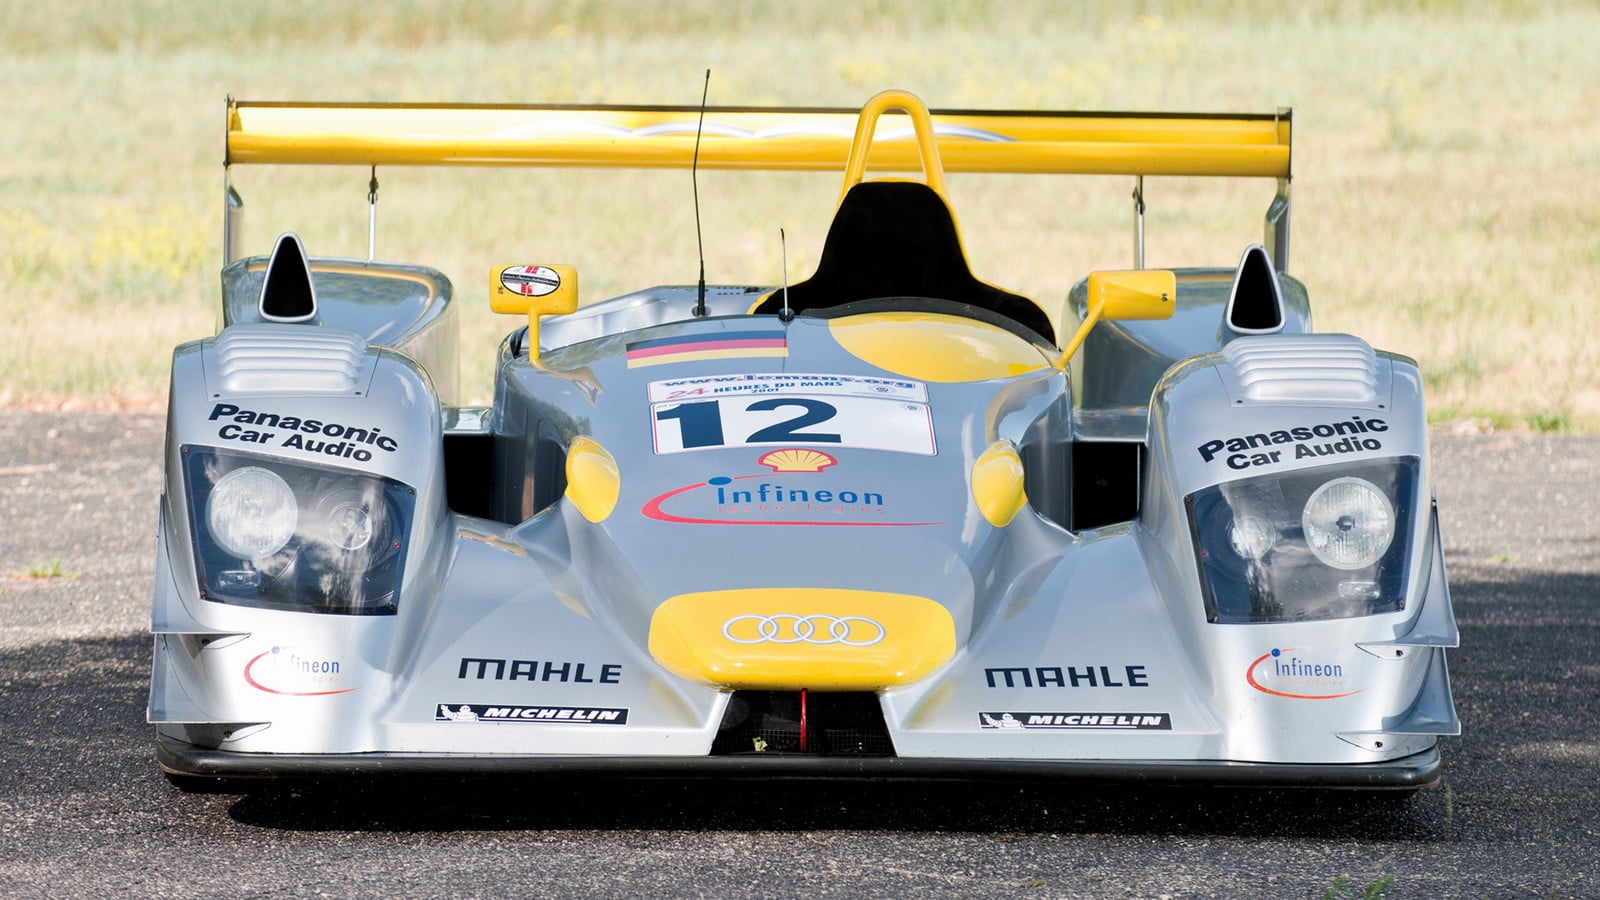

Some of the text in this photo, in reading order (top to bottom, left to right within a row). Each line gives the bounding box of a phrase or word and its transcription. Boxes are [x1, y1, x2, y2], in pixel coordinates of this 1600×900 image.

[664, 374, 916, 388] www.lemans.org
[667, 387, 709, 399] 24
[713, 383, 770, 393] HEURES
[208, 403, 398, 452] Panasonic
[656, 398, 842, 449] 12
[218, 424, 373, 462] Car Audio
[1198, 416, 1389, 463] Panasonic
[1226, 436, 1382, 470] Car Audio
[716, 483, 884, 506] Infineon
[716, 503, 885, 515] technologies
[458, 657, 623, 684] MAHLE
[984, 665, 1149, 688] MAHLE
[1275, 657, 1343, 677] Infineon
[483, 707, 621, 721] MICHELIN
[1027, 714, 1162, 726] MICHELIN
